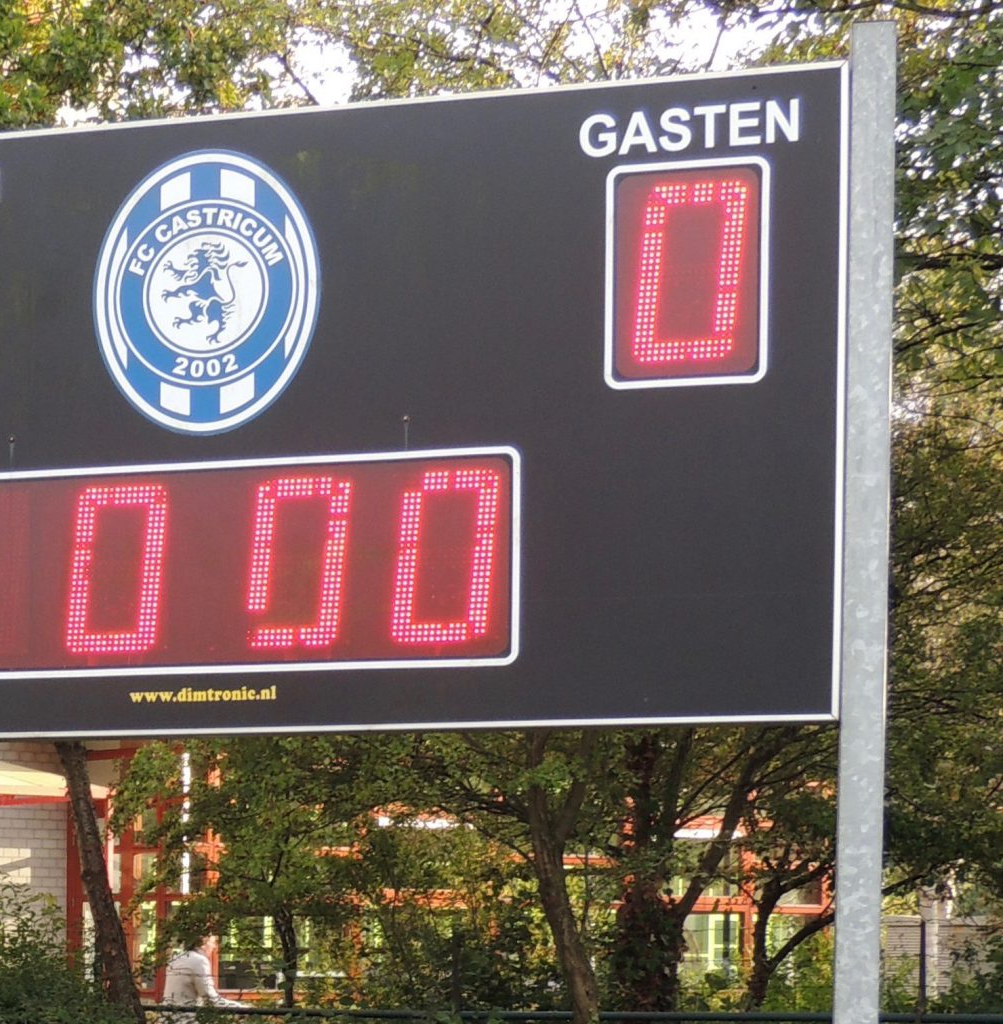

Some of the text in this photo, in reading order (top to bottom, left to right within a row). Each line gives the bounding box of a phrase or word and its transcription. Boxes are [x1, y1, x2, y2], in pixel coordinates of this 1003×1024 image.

[579, 98, 801, 158] GASTEN
[128, 207, 284, 277] FC CASTRICUM
[631, 179, 749, 365] 0
[171, 353, 239, 378] 2002
[129, 685, 277, 703] www.dimtronic.nl
